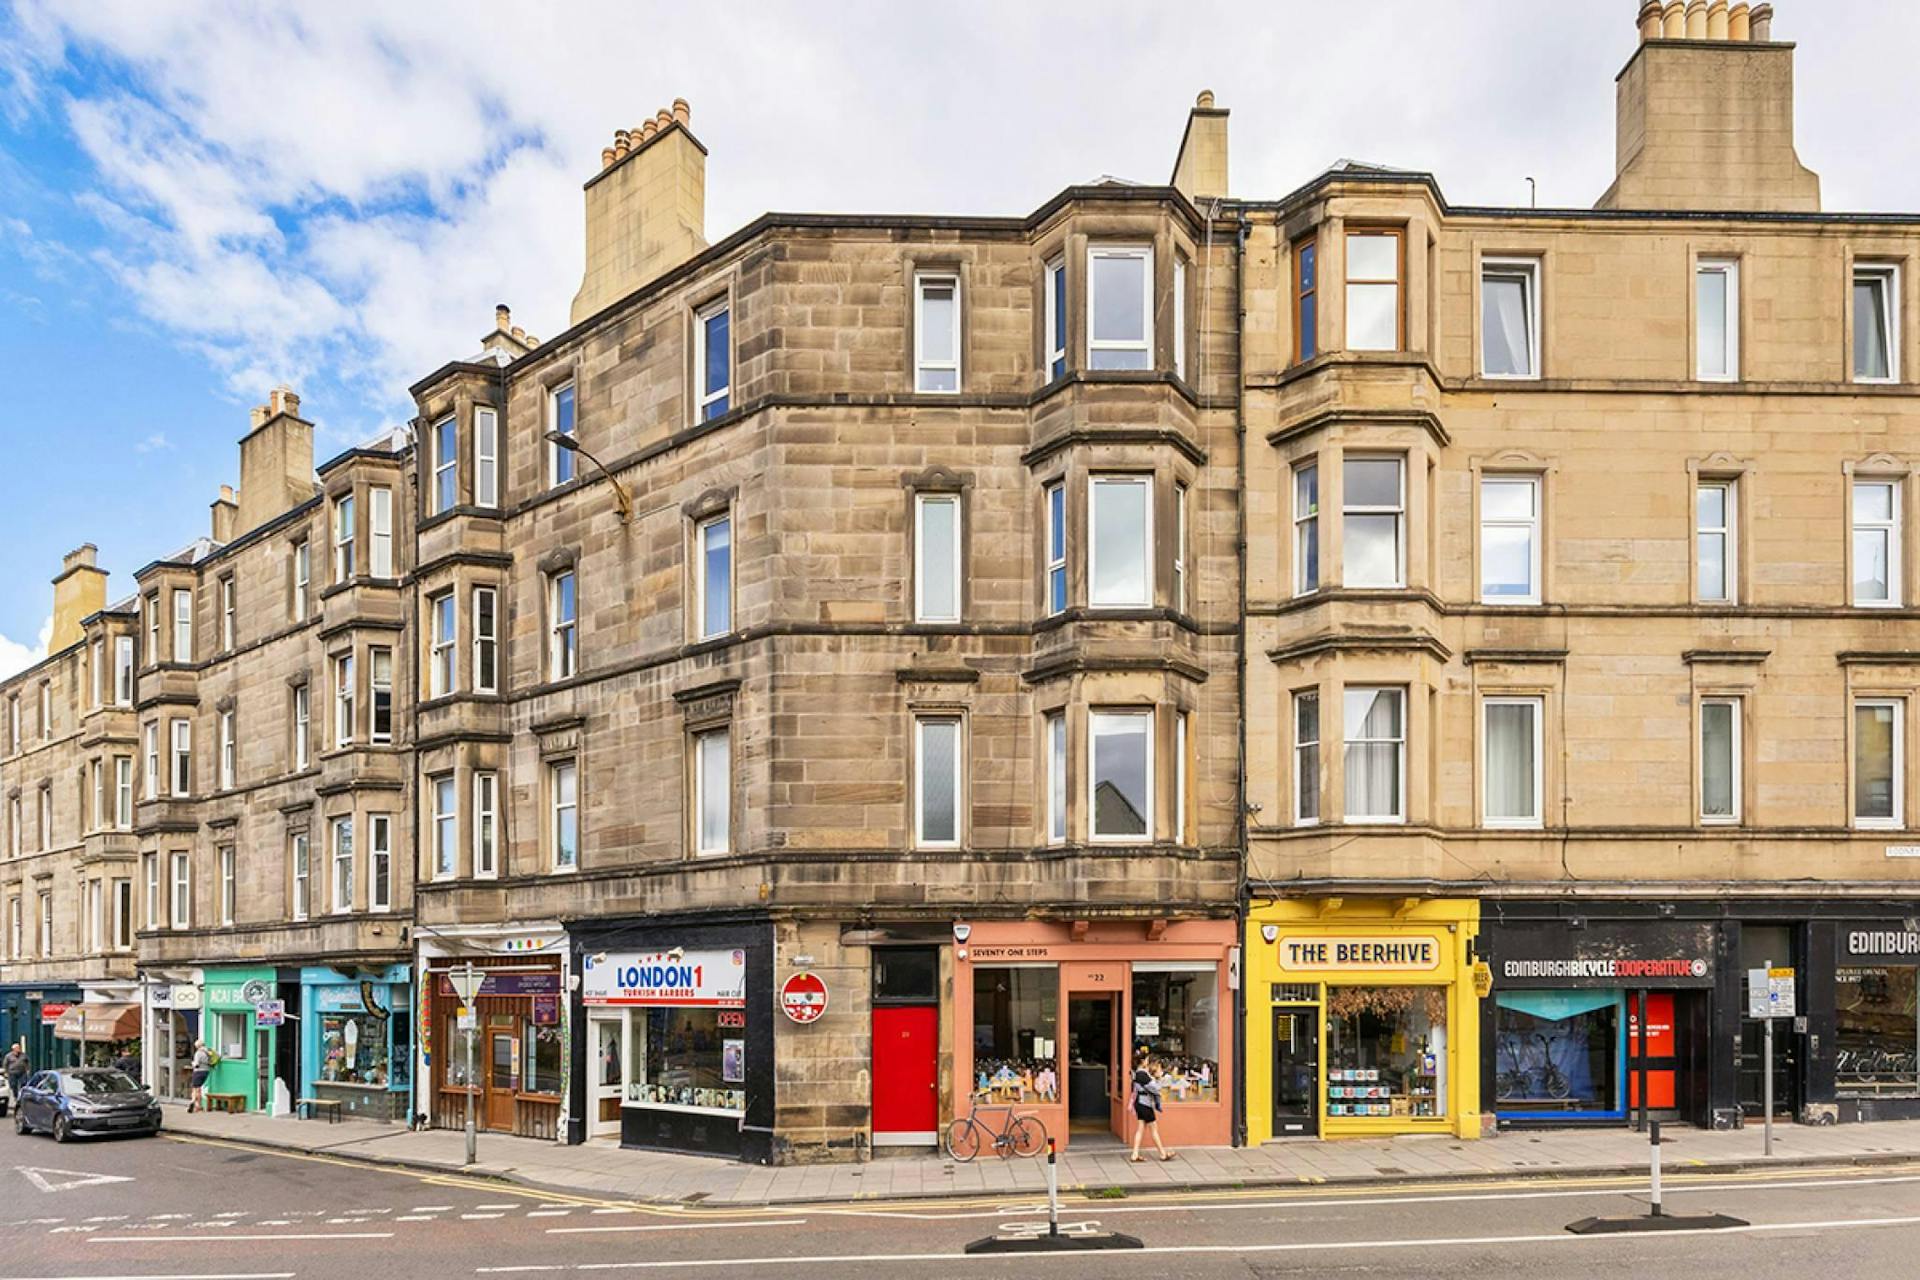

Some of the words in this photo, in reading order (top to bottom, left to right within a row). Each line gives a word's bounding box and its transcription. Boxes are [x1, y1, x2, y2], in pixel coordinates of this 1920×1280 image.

[973, 949, 1005, 957] SEVENTY
[1008, 949, 1024, 957] ONE
[1026, 949, 1048, 957] STEPS
[1289, 943, 1328, 963] THE
[1336, 943, 1432, 964] BEERHIVE
[623, 988, 657, 998] TURKISH
[659, 988, 695, 998] BARBERS
[718, 1011, 744, 1027] OPEN
